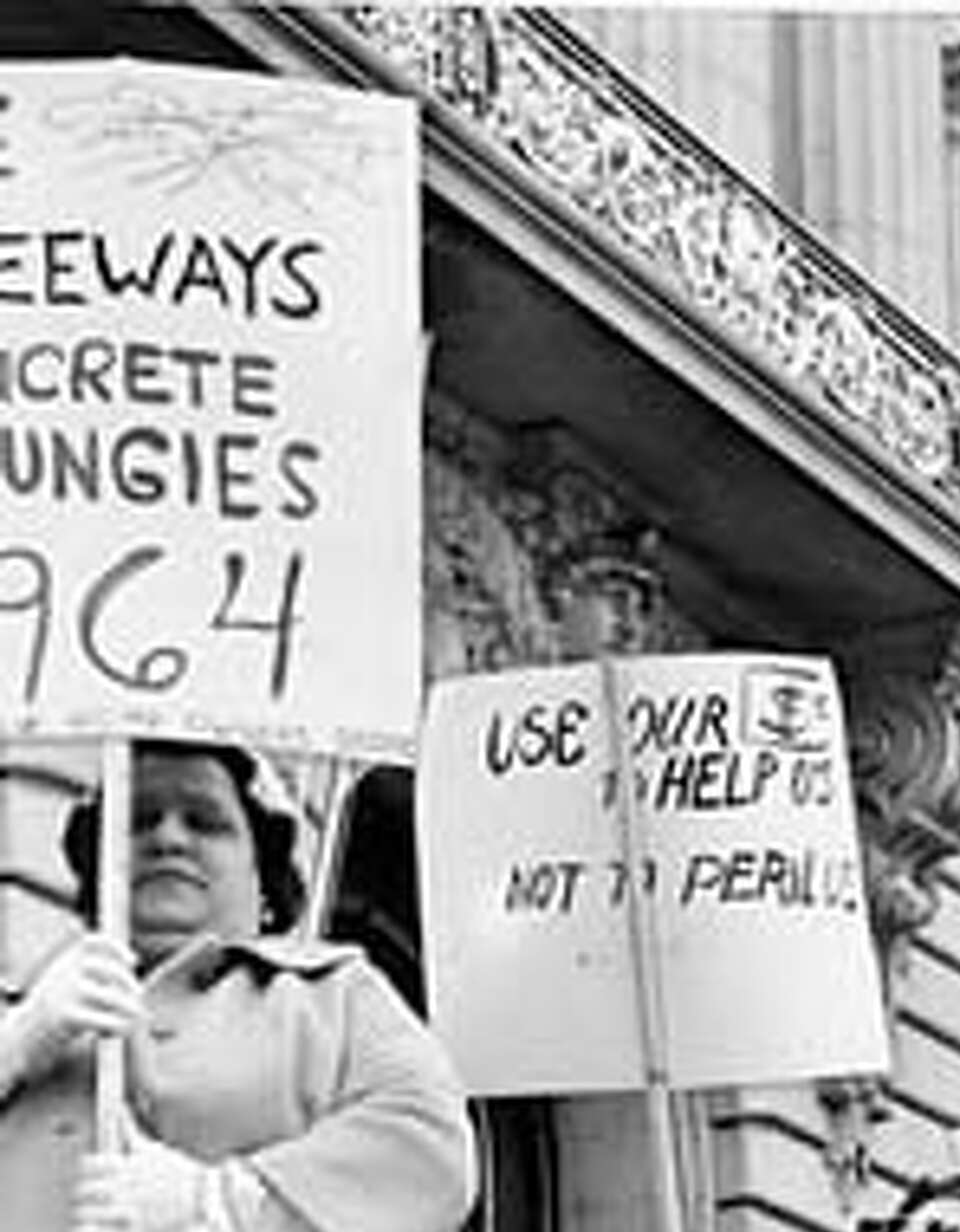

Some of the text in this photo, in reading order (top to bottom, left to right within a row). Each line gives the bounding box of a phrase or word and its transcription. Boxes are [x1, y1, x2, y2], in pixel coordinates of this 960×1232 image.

[484, 699, 588, 775] USE
[655, 751, 779, 812] HELP
[504, 862, 582, 914] NOT
